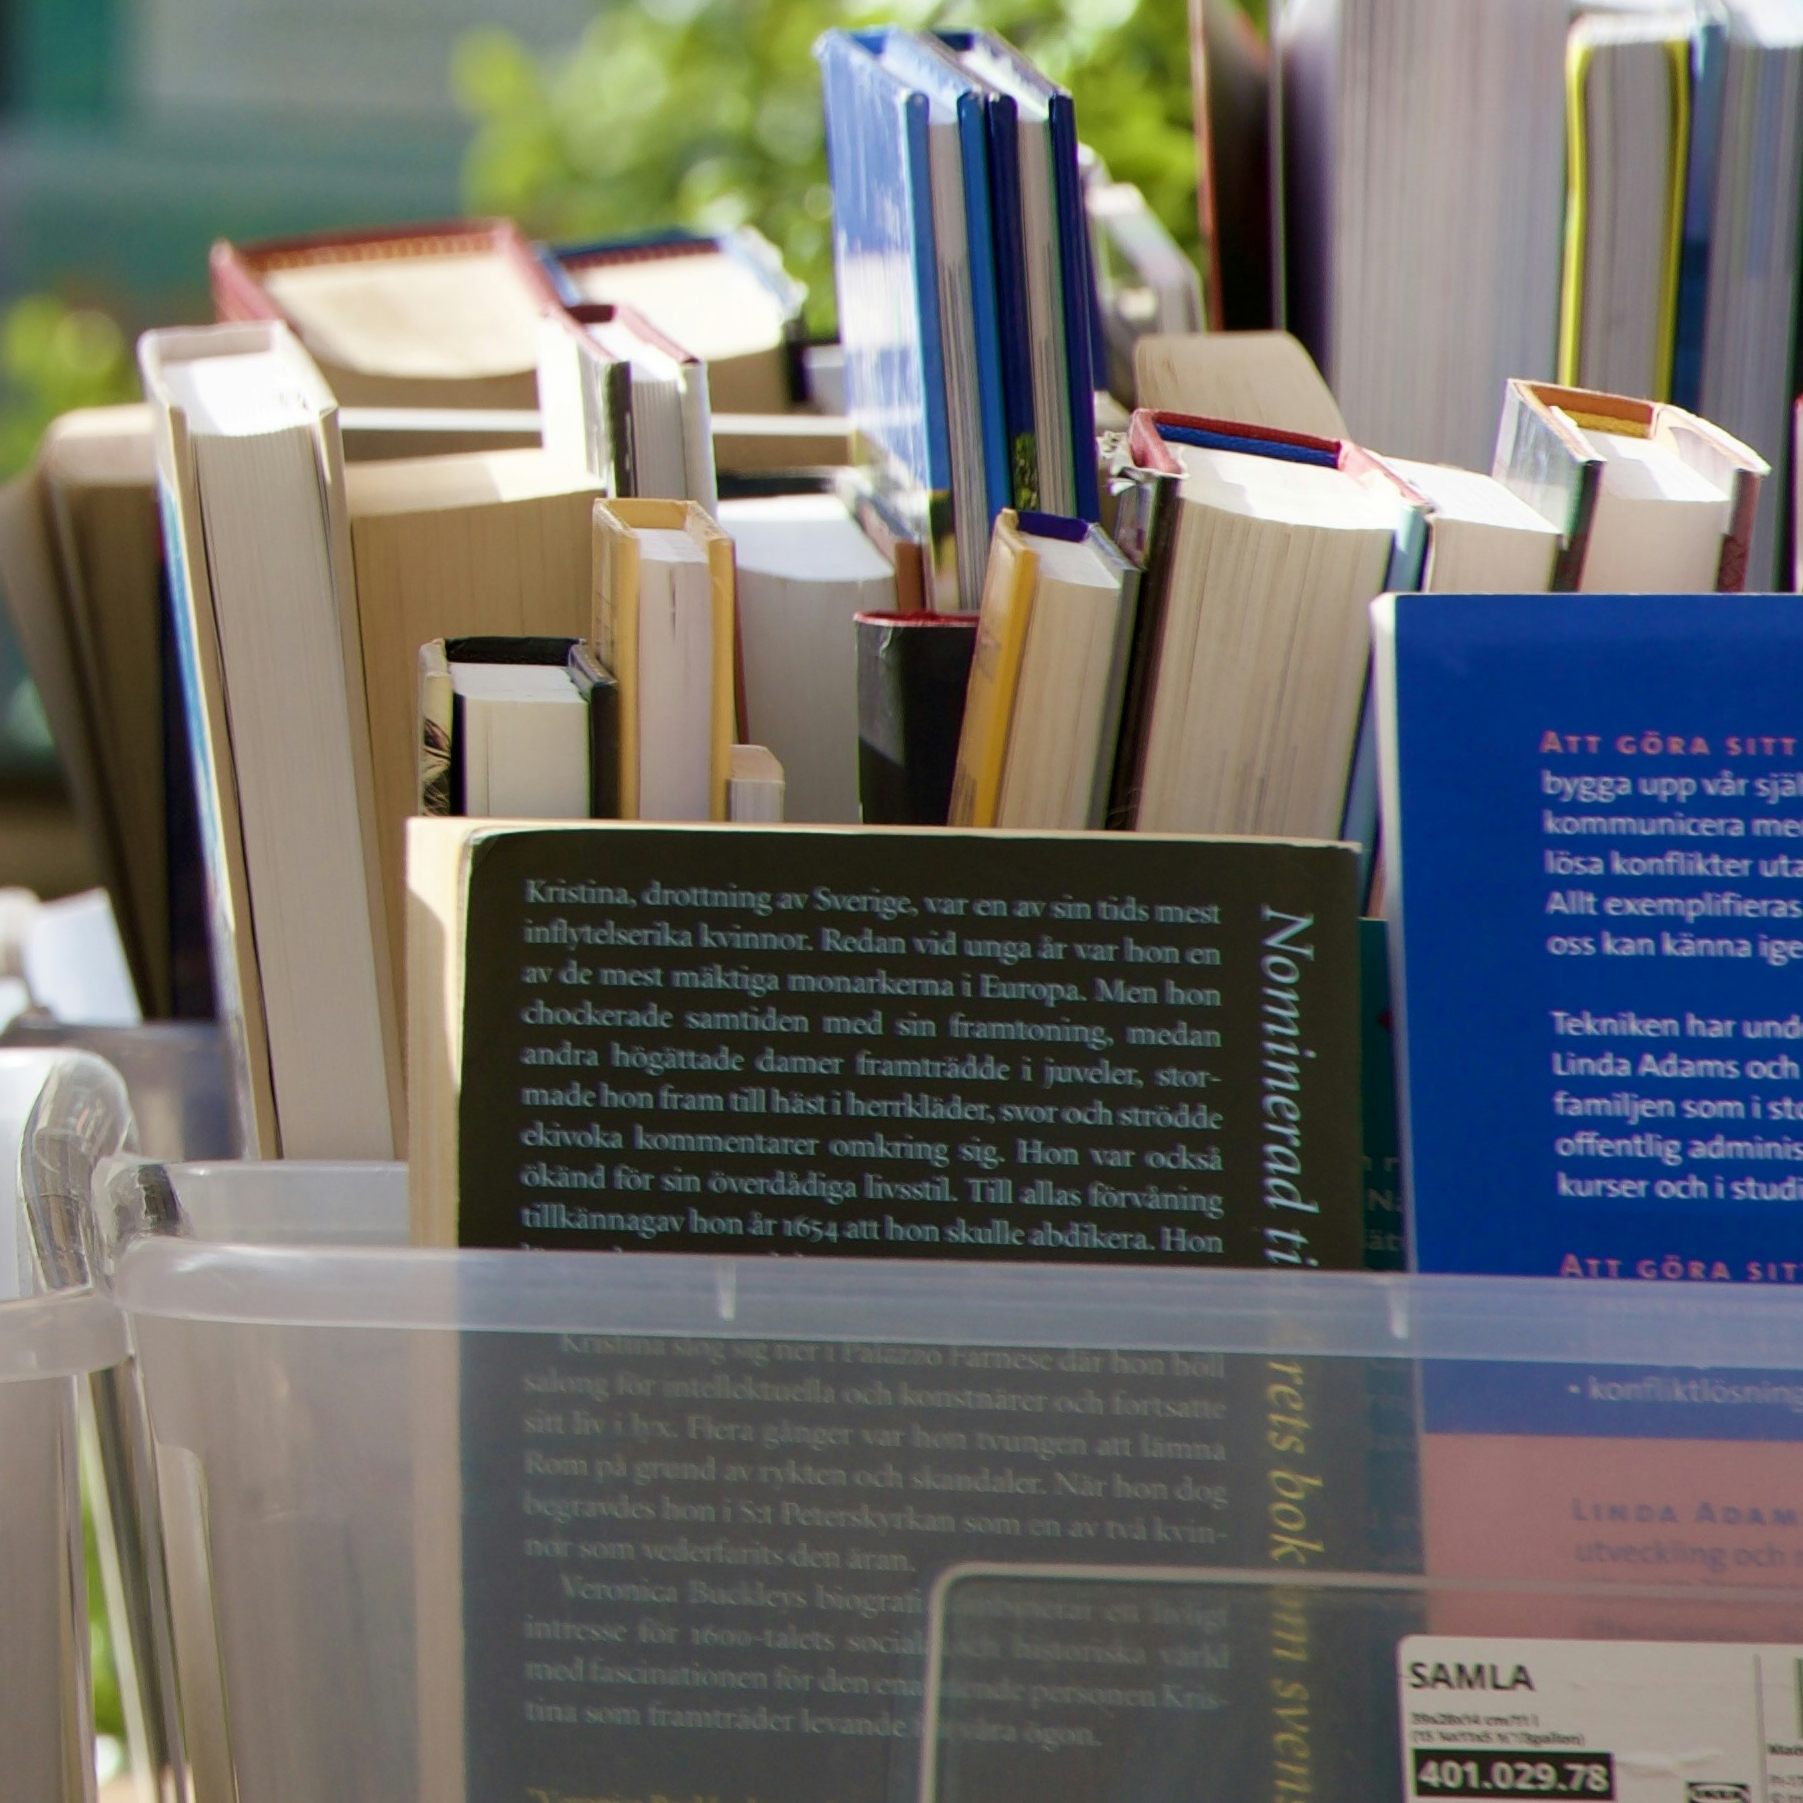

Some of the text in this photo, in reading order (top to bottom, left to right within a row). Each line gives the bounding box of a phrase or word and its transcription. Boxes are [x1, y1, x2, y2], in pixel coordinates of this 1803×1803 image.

[1541, 768, 1633, 805] bygga
[1637, 775, 1698, 806] upp
[1700, 770, 1749, 798] vår
[1542, 808, 1803, 838] kommunicera me
[1544, 847, 1605, 875] lösa
[1609, 849, 1753, 877] konflikter
[525, 876, 1222, 925] Kristina, drottning av Sverige, var en av sin tids mest
[1545, 887, 1803, 926] Allt exemplifieras
[523, 917, 1222, 968] inflytelserika kvinnor. Redan vid unga år var hon en
[1546, 934, 1597, 955] oss
[1600, 929, 1656, 956] kan
[1660, 930, 1753, 958] känna
[521, 958, 1222, 1011] av de mest mäktiga monarkerna i Europa. Men hon
[520, 999, 1222, 1052] chockerade samtiden med sin framtoning, medan
[1548, 1008, 1803, 1039] Tekniken har und
[520, 1039, 1221, 1095] andra högättade damer framträdde i juveler, stor-
[1261, 903, 1321, 1214] Nominerad
[1551, 1049, 1801, 1079] Linda Adams och
[521, 1080, 1224, 1130] made hon fram till häst i herrkläder, svor och strödde
[1552, 1089, 1677, 1126] familjen
[1680, 1097, 1746, 1119] som
[1751, 1092, 1762, 1119] i
[519, 1121, 1223, 1173] ekivoka kommentarer omkring sig. Hon var också
[1554, 1130, 1683, 1167] offentlig
[519, 1162, 1224, 1221] ökänd för sin överdådiga livsstil. Till allas förvåning
[1556, 1171, 1650, 1198] kurser
[1653, 1172, 1709, 1200] och
[1714, 1173, 1726, 1200] i
[520, 1204, 1224, 1253] tillkännagav hon år 1654 att hon skulle abdikera. Hon
[1262, 1227, 1320, 1267] ti
[1746, 1254, 1803, 1281] SIT
[1267, 1359, 1314, 1455] rets
[1268, 1467, 1325, 1565] bok
[1696, 1500, 1803, 1527] ADAM
[1408, 1661, 1536, 1692] SAMLA
[1418, 1760, 1611, 1794] 401.029.78
